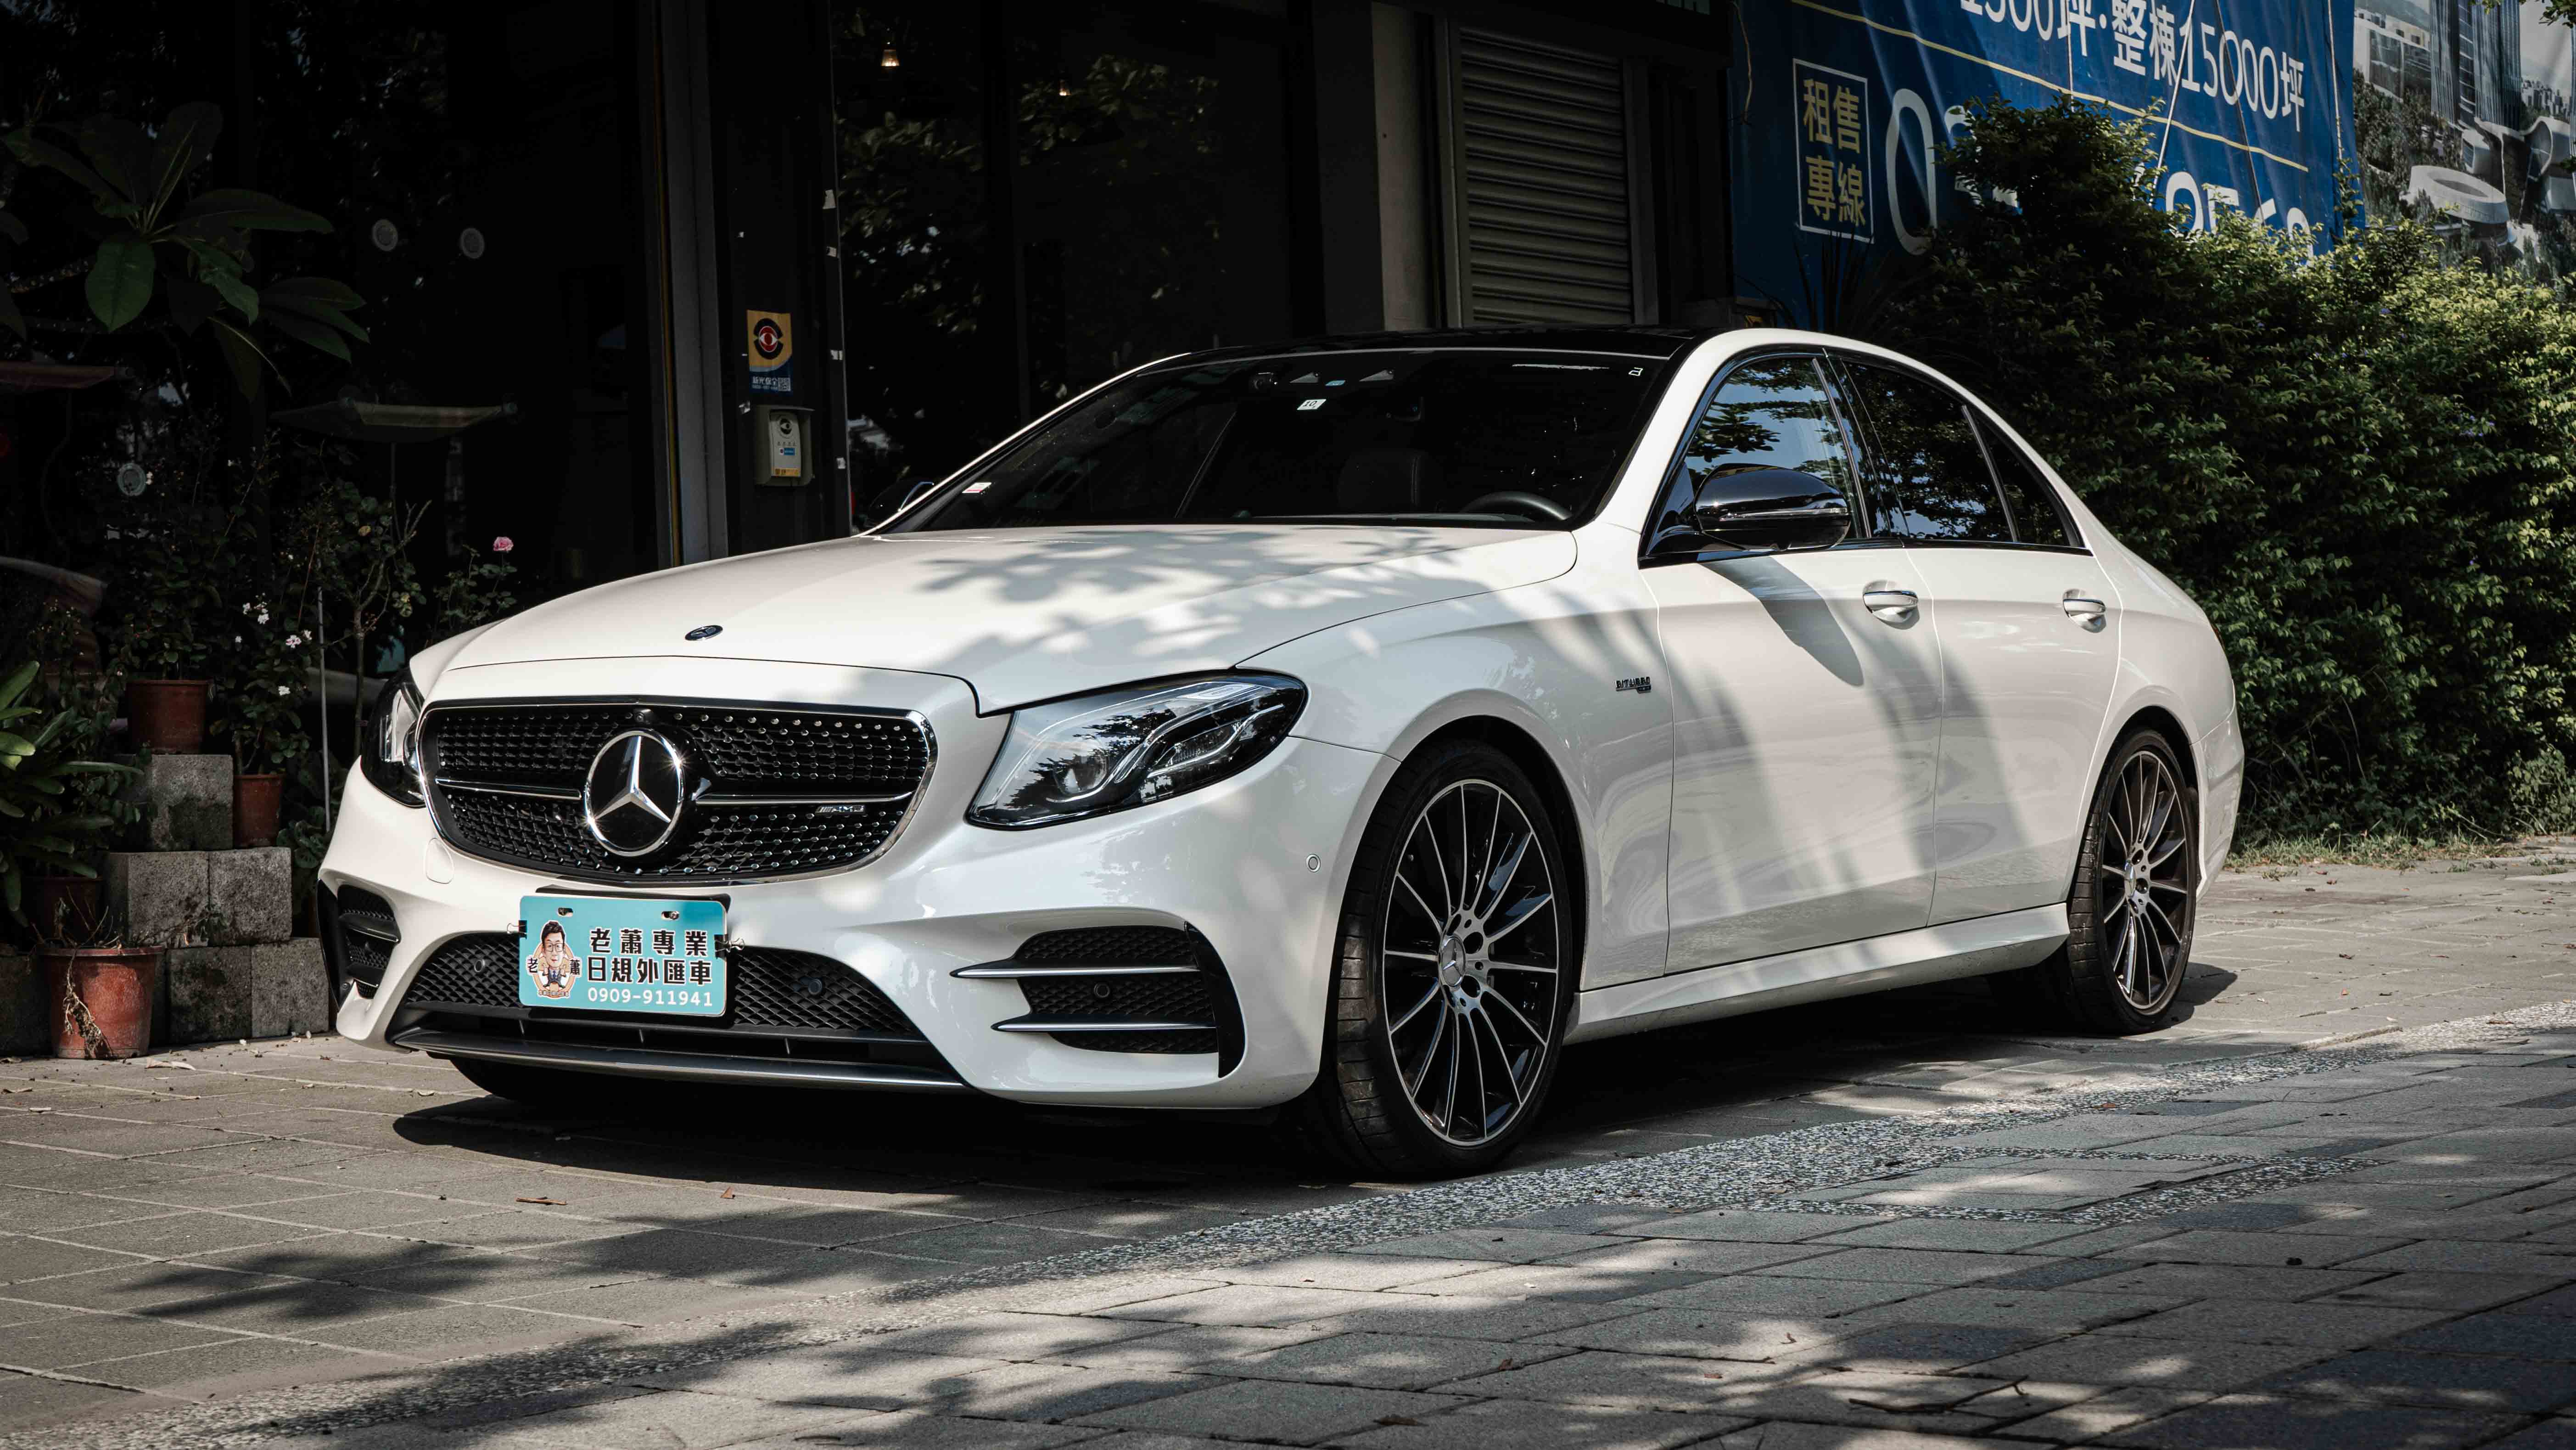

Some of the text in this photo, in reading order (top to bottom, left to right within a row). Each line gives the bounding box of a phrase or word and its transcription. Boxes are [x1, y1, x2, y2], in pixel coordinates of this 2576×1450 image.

[1803, 78, 1861, 154] 租售
[1805, 155, 1866, 227] 專線
[590, 928, 707, 956] 老蕭專業
[527, 957, 580, 975] 老 蕭
[588, 956, 711, 985] 日規外匯車
[588, 988, 712, 1006] 0909-911941
